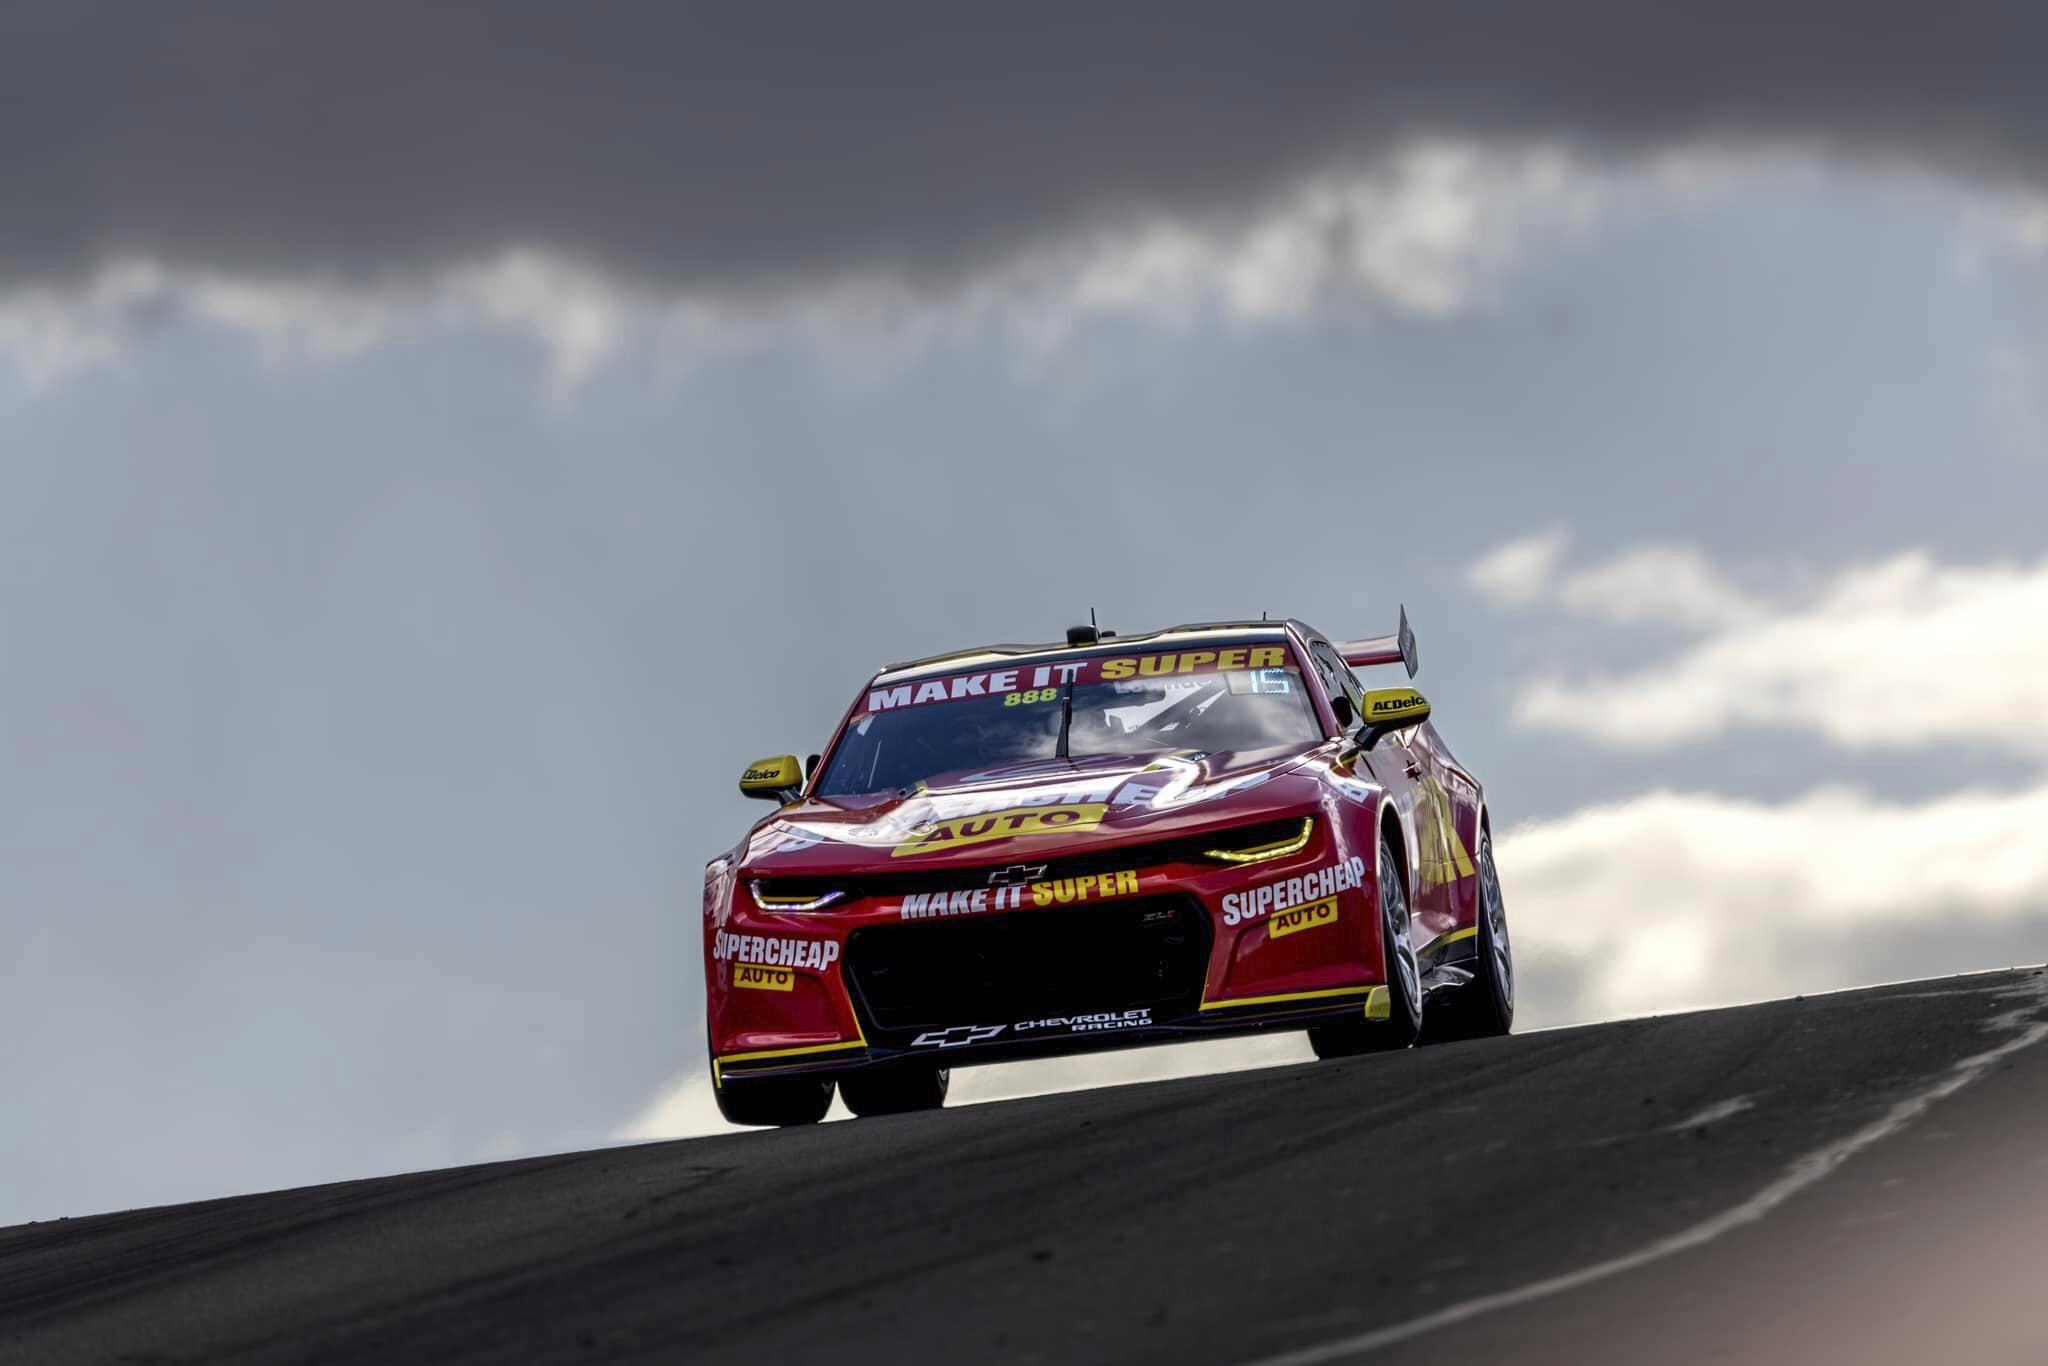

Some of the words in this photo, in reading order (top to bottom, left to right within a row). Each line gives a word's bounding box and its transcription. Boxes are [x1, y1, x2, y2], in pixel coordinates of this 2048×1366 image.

[868, 668, 1018, 712] MAKE
[1033, 662, 1089, 687] IT
[1100, 647, 1287, 680] SUPER
[1249, 668, 1289, 695] 15
[1003, 687, 1058, 707] 888
[917, 810, 1081, 846] AUTO
[900, 889, 990, 920] MAKE
[993, 884, 1027, 911] IT
[1031, 870, 1139, 906] SUPER
[1222, 856, 1366, 926] SUPERCHEAP
[1275, 903, 1331, 931] AUTO
[713, 927, 840, 972] SUPERCHEAP
[740, 967, 789, 986] AUTO
[1014, 1008, 1152, 1031] CHEVROLET
[1071, 1018, 1153, 1032] RACING
